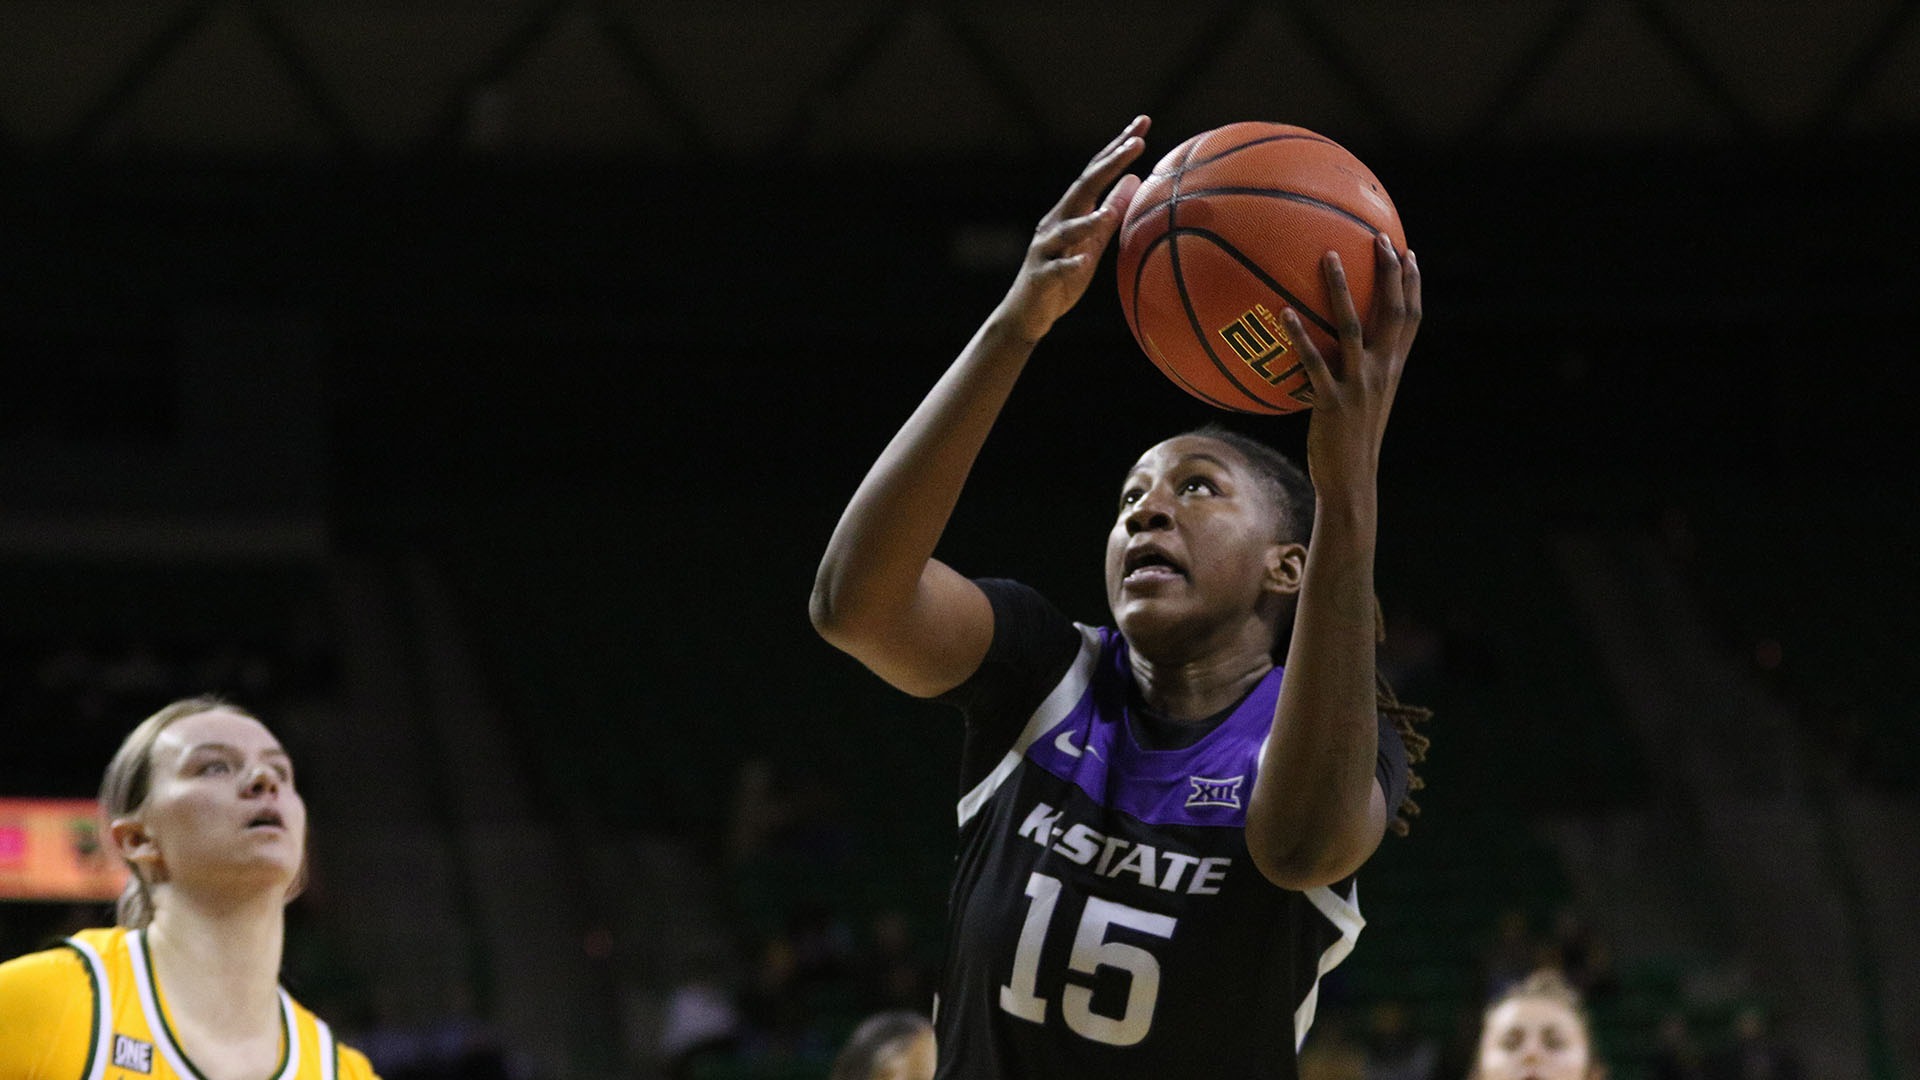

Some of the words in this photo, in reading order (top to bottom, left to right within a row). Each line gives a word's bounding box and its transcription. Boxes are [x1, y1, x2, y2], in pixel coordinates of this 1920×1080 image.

[1184, 775, 1244, 809] XII
[1017, 802, 1232, 895] K-STATE
[1000, 871, 1178, 1047] 15
[115, 1035, 151, 1073] ONE
